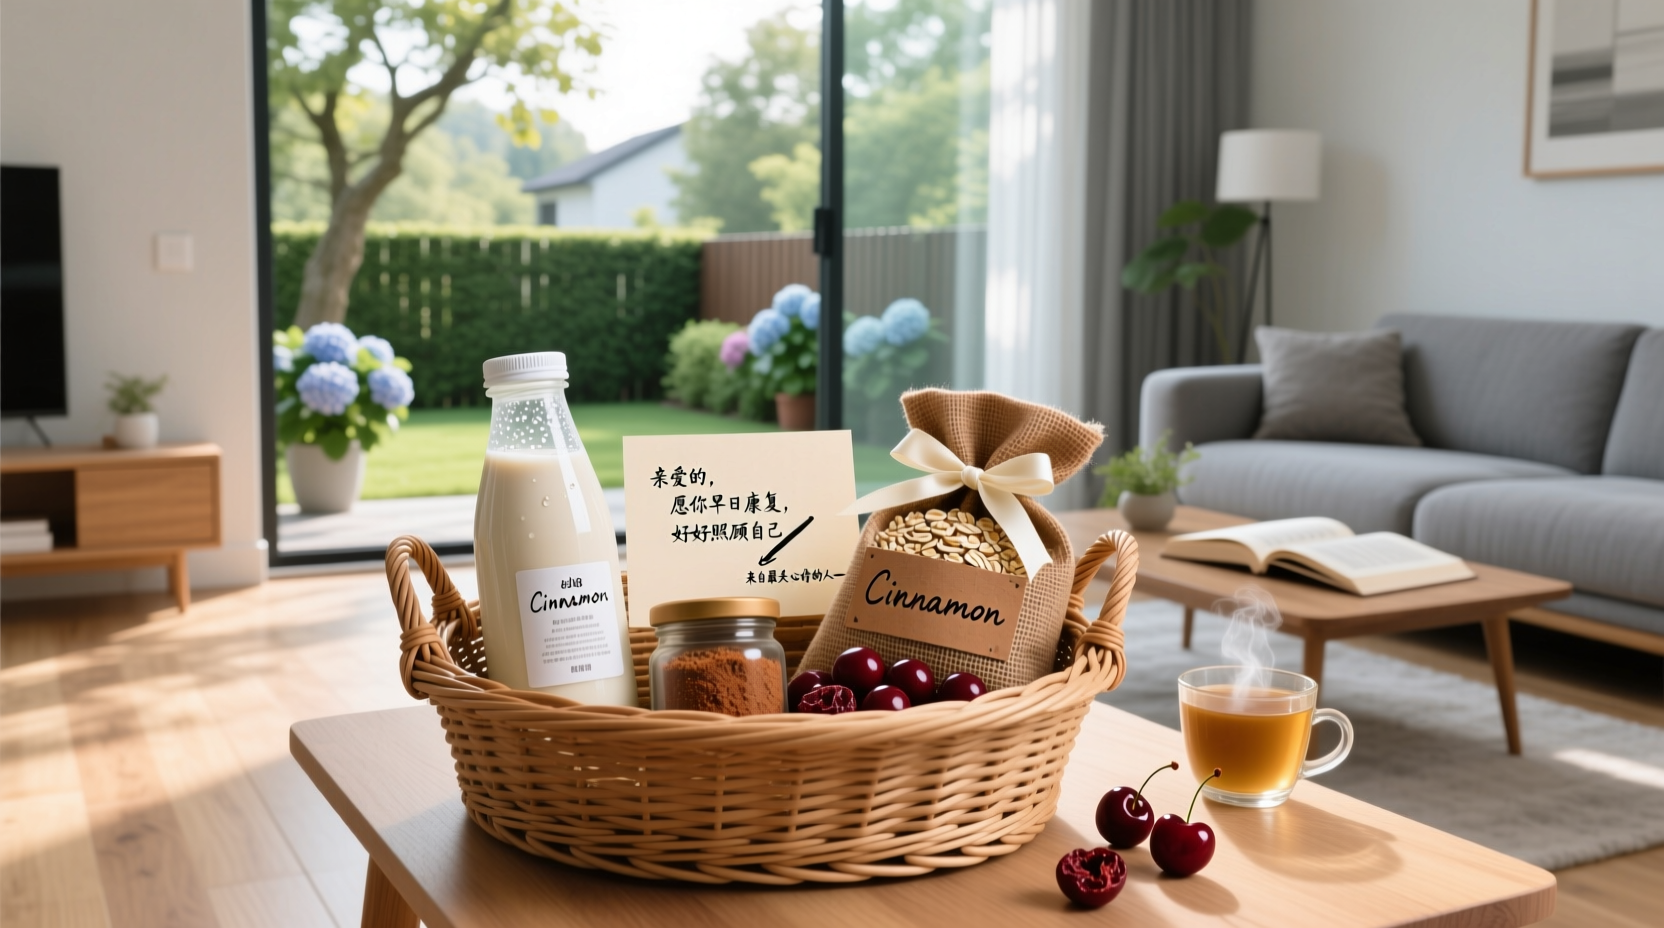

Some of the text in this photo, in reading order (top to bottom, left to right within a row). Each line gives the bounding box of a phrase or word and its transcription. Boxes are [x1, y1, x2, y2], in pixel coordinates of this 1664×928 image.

[671, 521, 783, 543] 好好照顾自己
[865, 569, 1005, 626] Cinnamon
